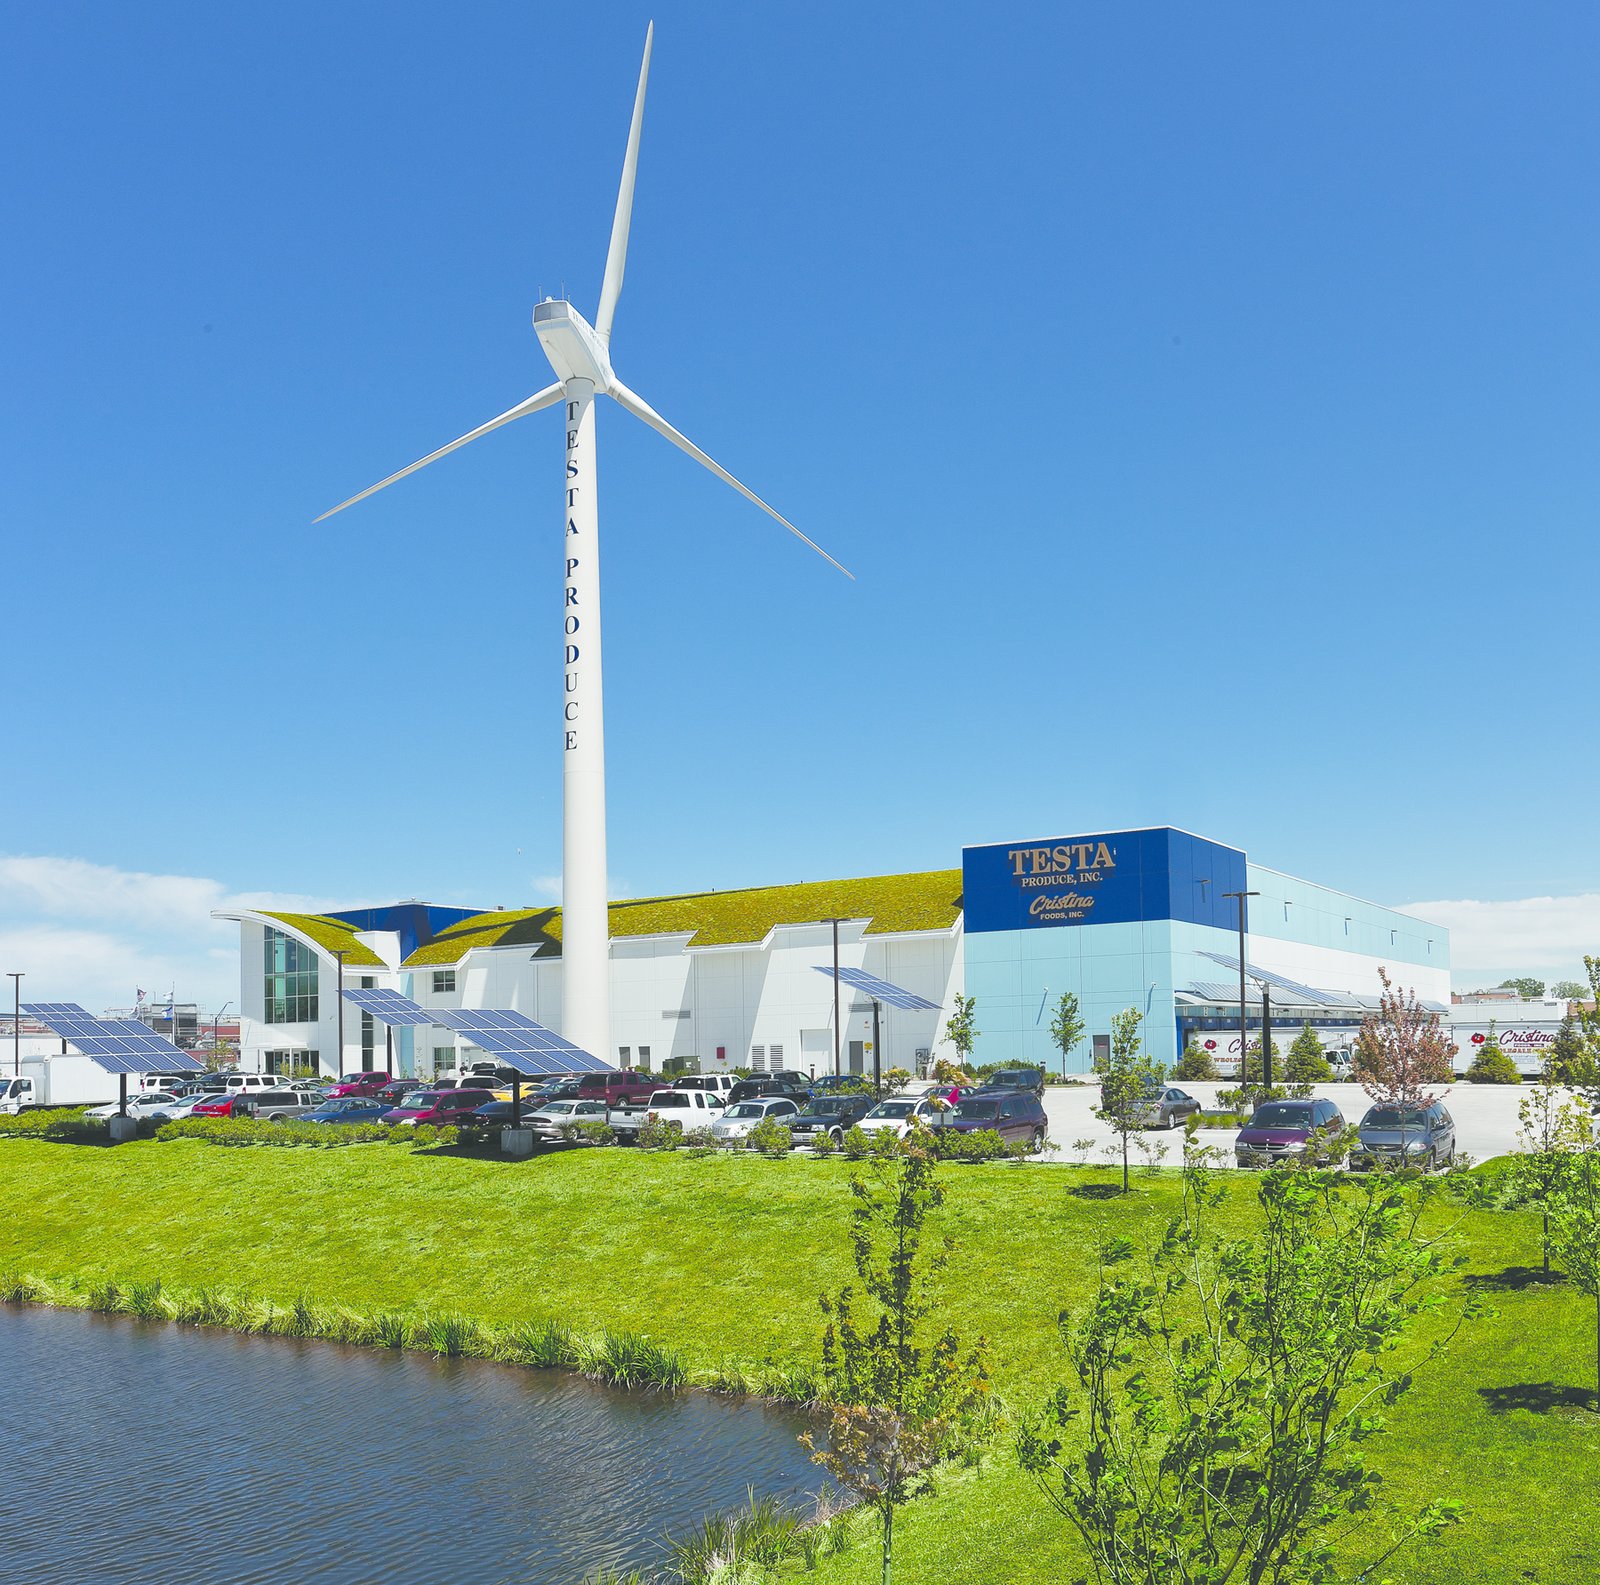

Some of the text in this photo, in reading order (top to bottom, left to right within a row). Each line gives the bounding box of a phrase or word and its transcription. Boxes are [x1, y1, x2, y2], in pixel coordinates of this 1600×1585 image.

[564, 401, 580, 751] TESTA PRODUCE
[1008, 842, 1116, 875] TESTA
[1021, 871, 1103, 887] PRODUCE, INC.
[1030, 892, 1095, 914] Cristina
[1040, 912, 1067, 920] FOODS,
[1499, 1029, 1555, 1045] Cristina
